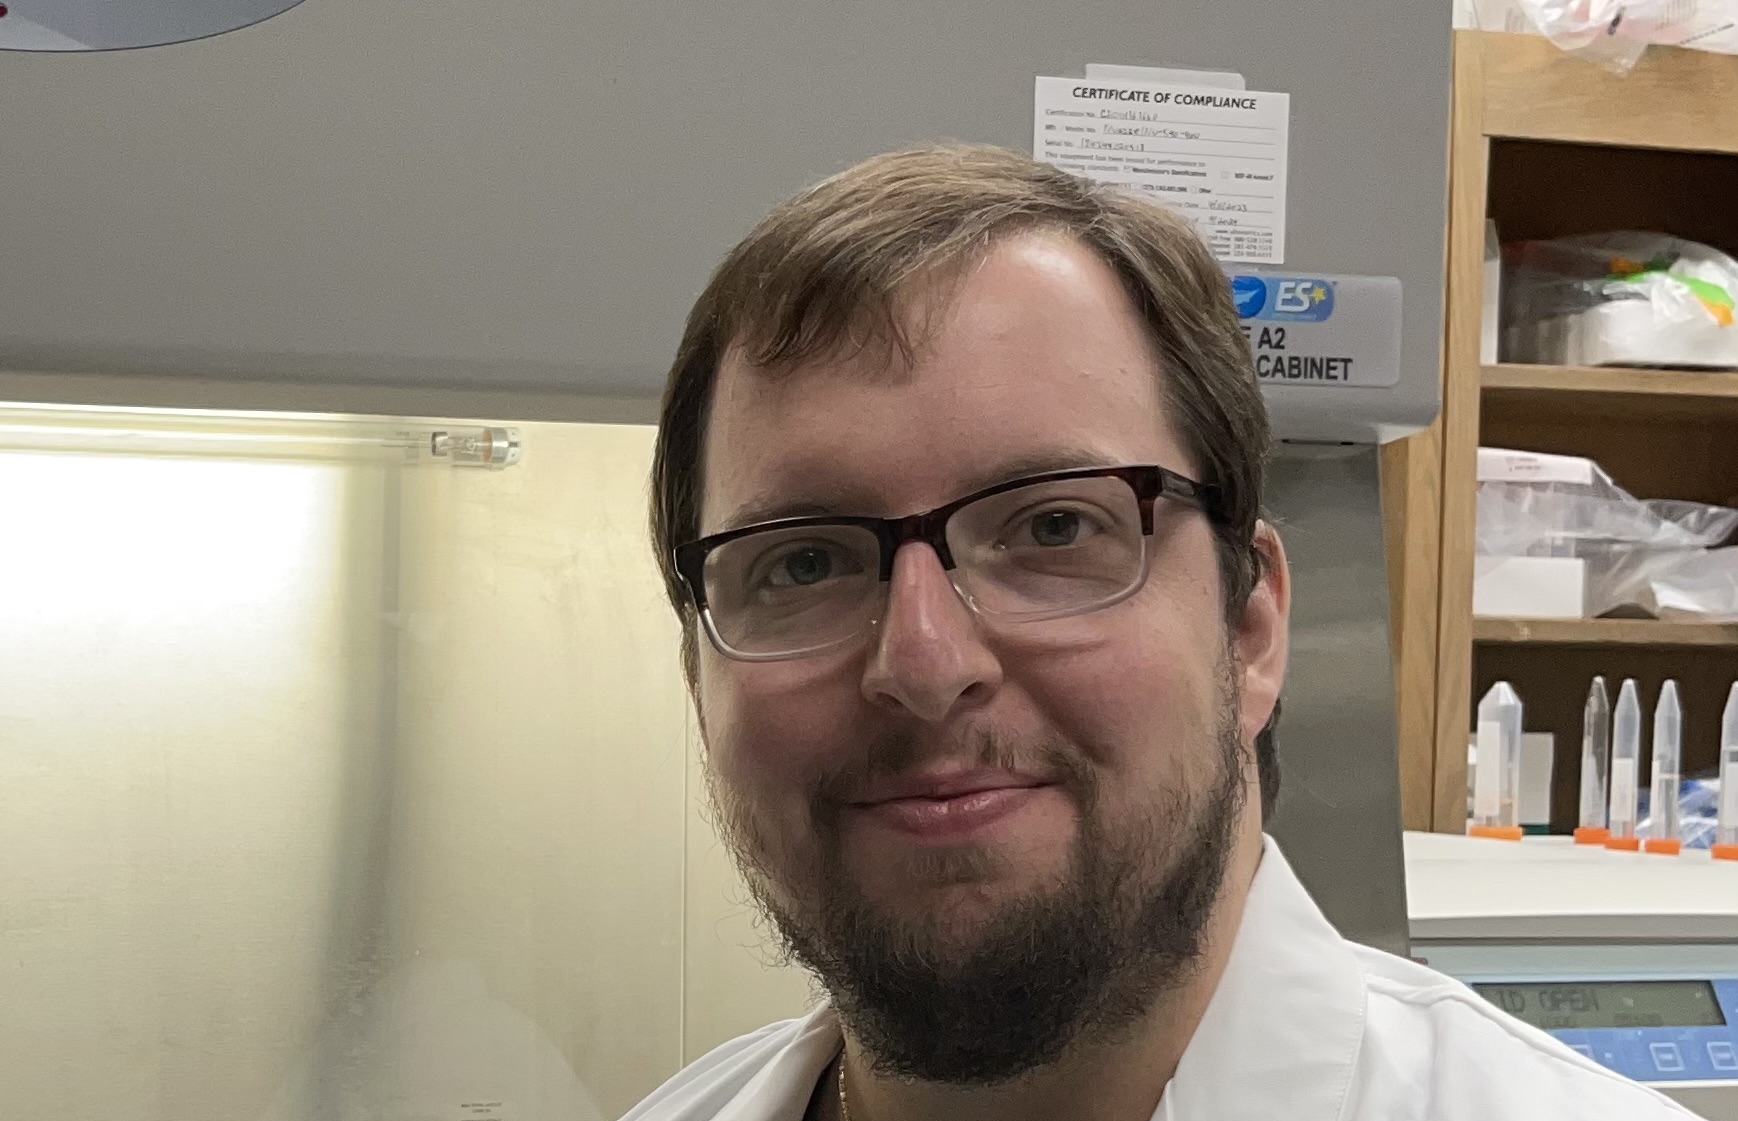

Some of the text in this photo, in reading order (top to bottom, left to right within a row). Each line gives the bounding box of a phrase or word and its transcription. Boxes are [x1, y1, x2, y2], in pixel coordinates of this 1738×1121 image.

[1072, 87, 1257, 110] CERTIFICATE OF COMPLIANCE
[1275, 281, 1313, 313] ES
[1257, 326, 1286, 350] A2
[1256, 354, 1354, 382] CABINET
